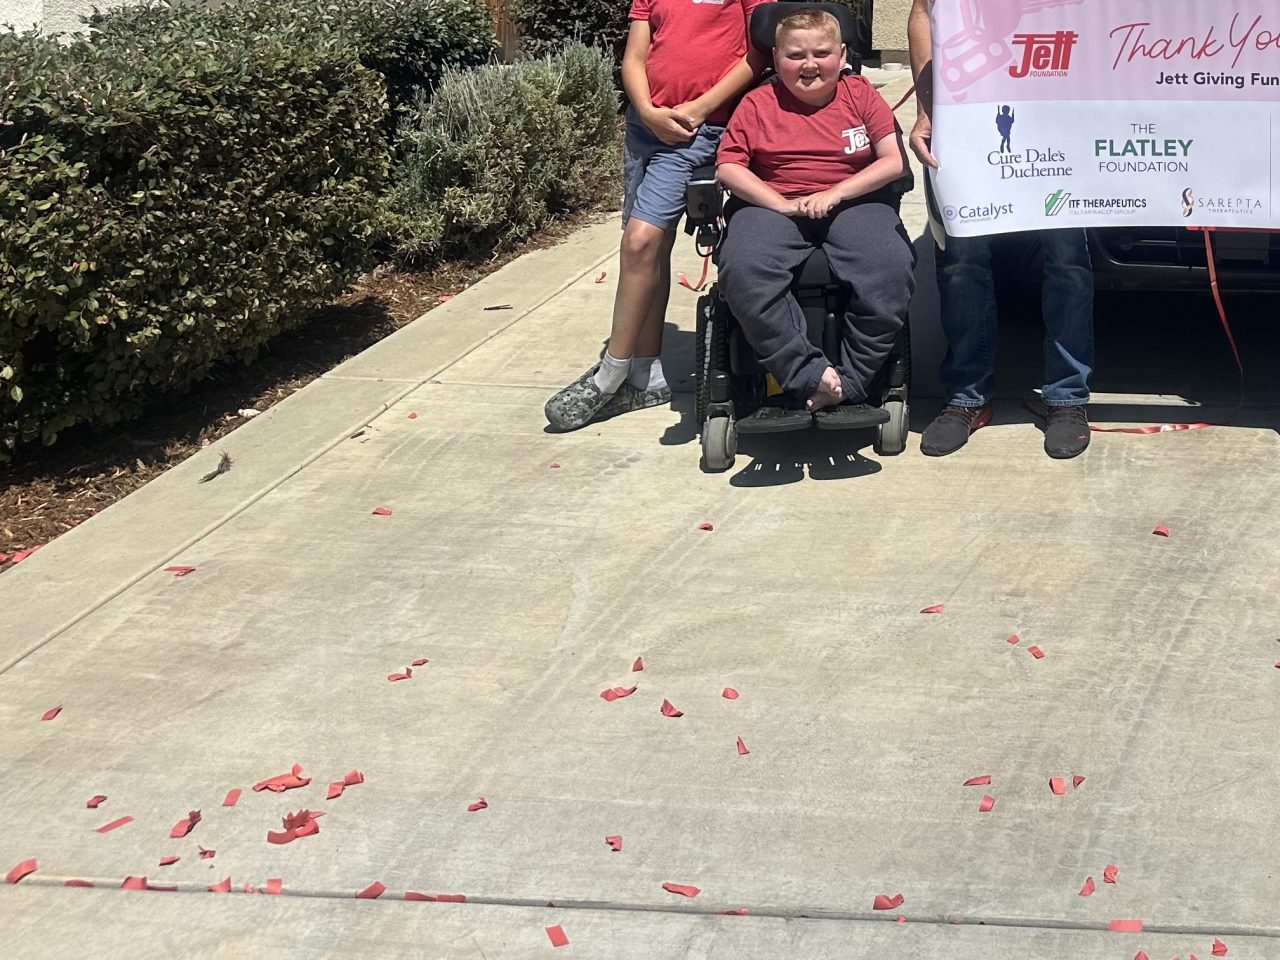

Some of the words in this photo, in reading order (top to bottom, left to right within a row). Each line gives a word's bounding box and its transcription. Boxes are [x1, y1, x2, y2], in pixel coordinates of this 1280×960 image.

[1008, 30, 1079, 79] Jett
[1109, 22, 1225, 71] Thank
[1029, 70, 1068, 78] FOUNDATION
[1156, 72, 1188, 85] Jett
[1193, 72, 1245, 88] Giving
[1130, 123, 1156, 134] THE
[1095, 139, 1194, 157] FLATLEY
[987, 150, 1022, 166] Cure
[1025, 147, 1065, 163] Dale's
[1000, 164, 1073, 180] Duchenne
[1099, 161, 1188, 173] FOUNDATION
[958, 202, 1014, 220] Catalyst
[1068, 199, 1082, 209] ITF
[1083, 198, 1147, 208] THERAPEUTICS
[1198, 197, 1262, 209] SAREPTA
